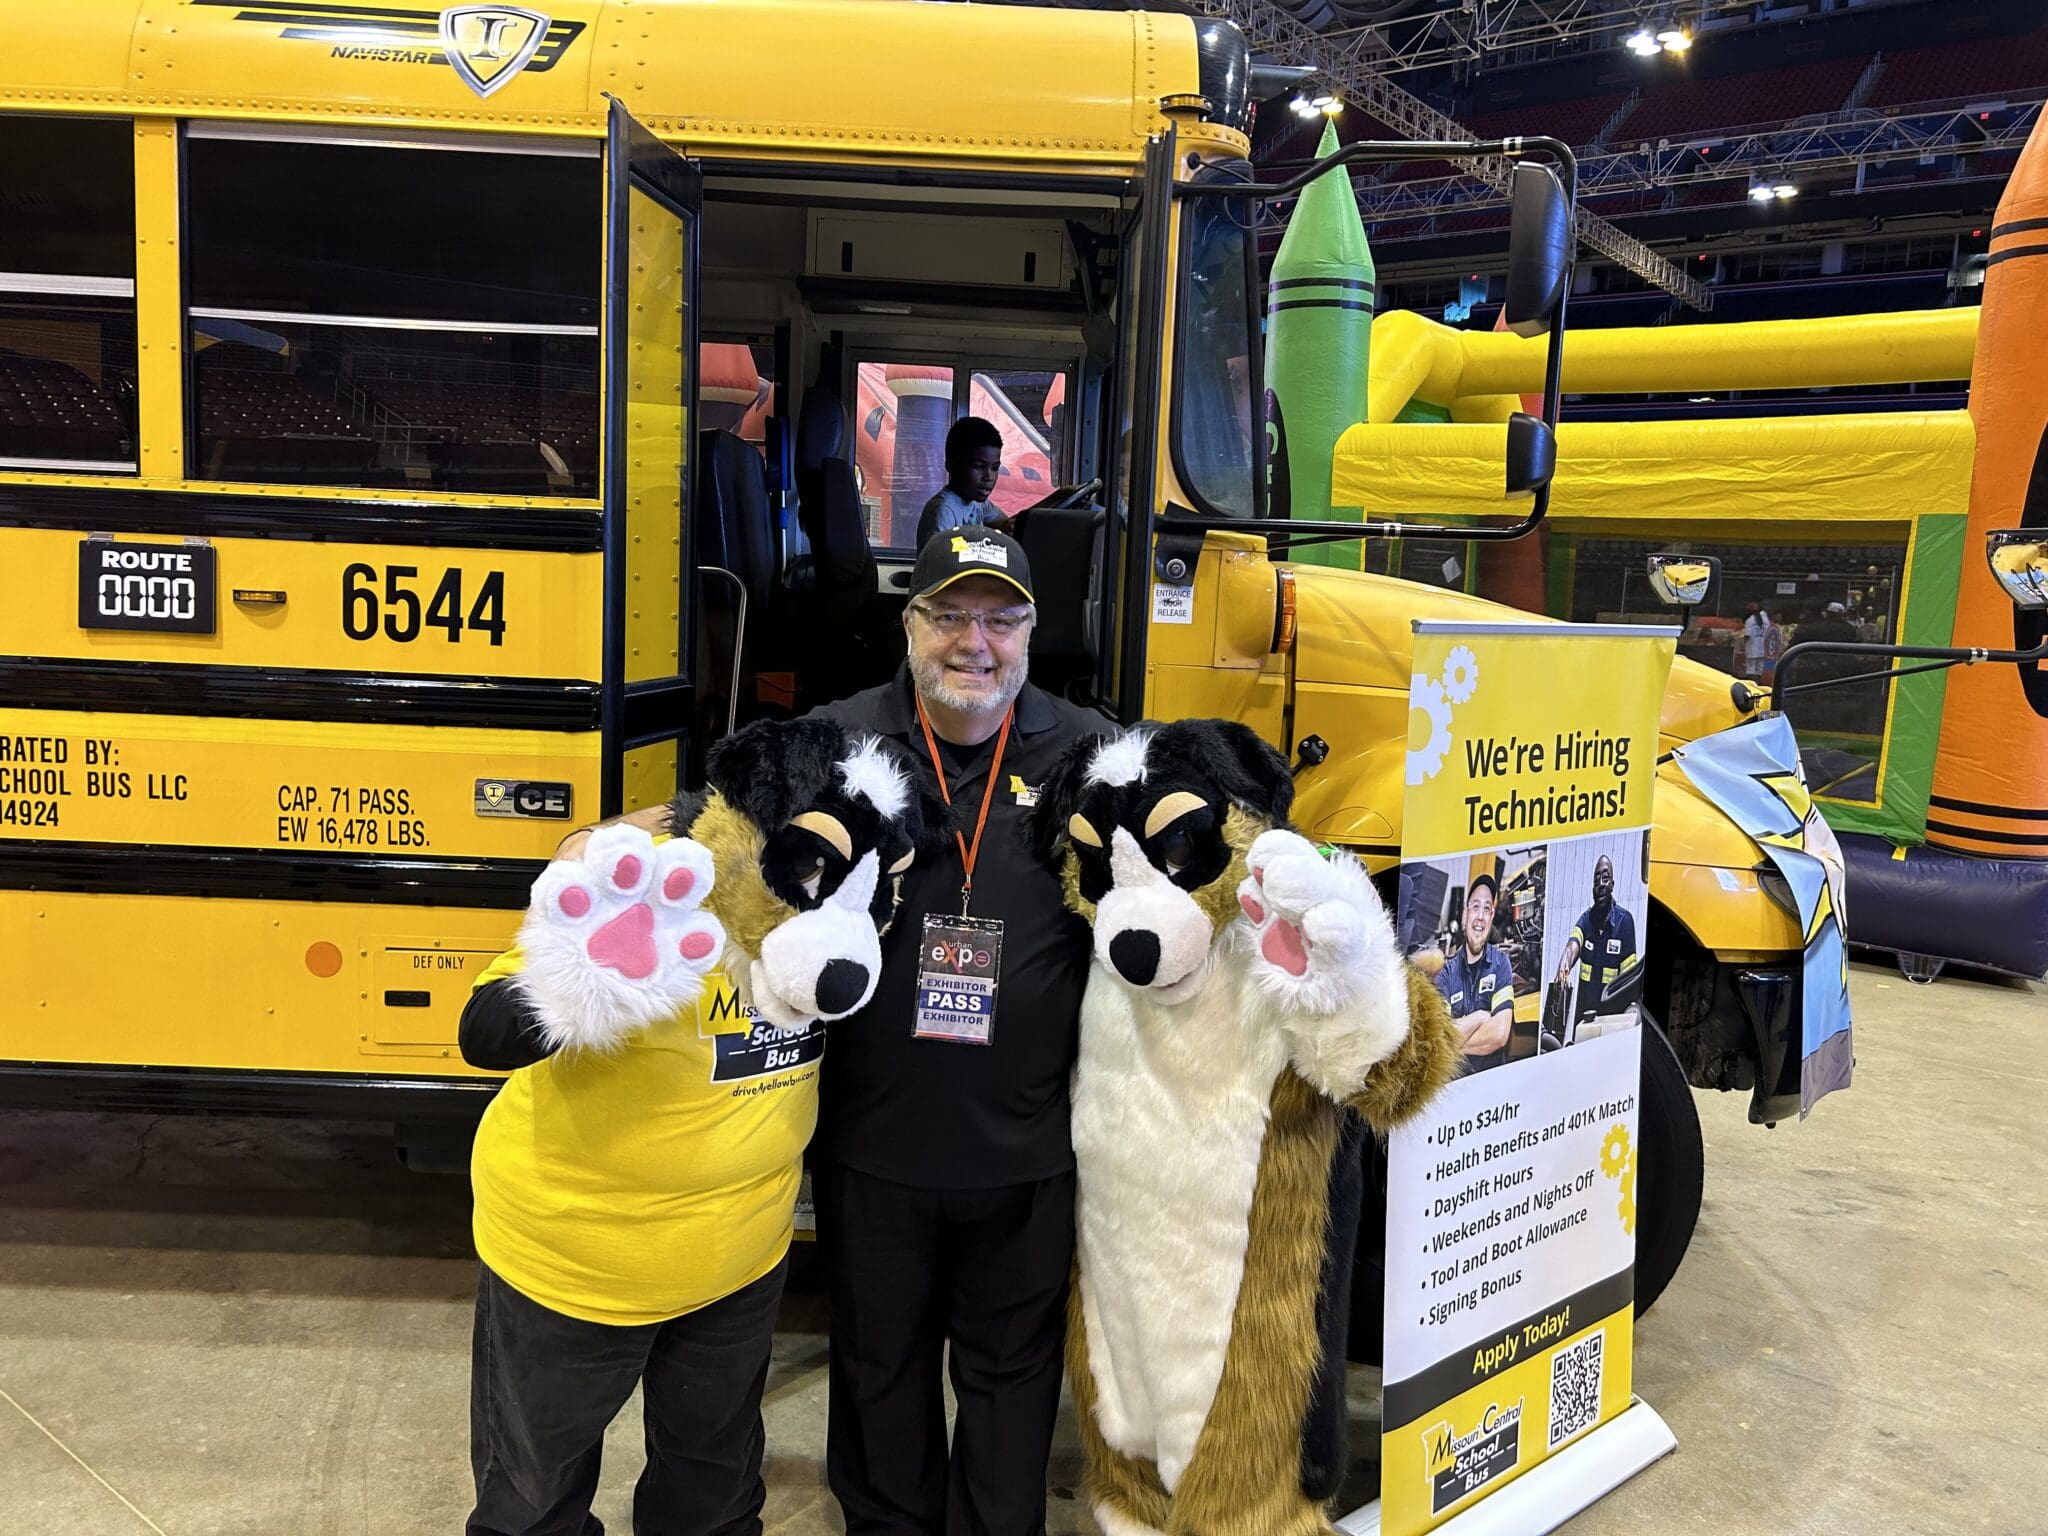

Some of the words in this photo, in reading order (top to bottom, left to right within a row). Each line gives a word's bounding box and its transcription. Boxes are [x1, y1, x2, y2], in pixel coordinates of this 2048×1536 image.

[330, 46, 430, 64] NAVISTAR
[102, 550, 192, 572] ROUTE
[99, 574, 195, 619] 0000
[341, 562, 506, 647] 6544
[1156, 590, 1191, 598] ENTRANCE
[1158, 609, 1186, 617] RELEASE
[0, 736, 67, 763] RATED
[86, 740, 119, 766] BY:
[1555, 729, 1631, 776] Hiring
[0, 768, 71, 795] CHOOL
[88, 771, 131, 798] BUS
[149, 774, 187, 800] LLC
[278, 785, 322, 812] CAP.
[331, 788, 350, 813] 71
[359, 788, 415, 815] PASS.
[520, 789, 565, 811] CE
[1465, 781, 1626, 835] Technicians!
[278, 816, 308, 842] EW
[317, 817, 377, 848] 16,478
[388, 820, 430, 846] LBS.
[413, 955, 433, 968] DEF
[437, 955, 464, 969] ONLY
[927, 978, 987, 992] EXHIBITOR
[927, 991, 981, 1011] PASS
[708, 986, 759, 1021] Miss
[923, 1012, 983, 1025] EXHIBITOR
[764, 1048, 800, 1069] Bus
[1435, 1148, 1480, 1182] Health
[1484, 1130, 1539, 1162] Benefits
[1542, 1117, 1565, 1142] and
[1567, 1106, 1596, 1131] 401K
[1599, 1094, 1634, 1121] Match
[1437, 1125, 1455, 1147] Up
[1459, 1119, 1472, 1136] to
[1476, 1102, 1520, 1131] $34/hr
[1434, 1180, 1490, 1217] Dayshift
[1494, 1165, 1533, 1193] Hours
[1432, 1209, 1501, 1254] Weekends
[1504, 1199, 1529, 1222] and
[1533, 1182, 1572, 1213] Nights
[1575, 1169, 1595, 1192] Off
[1430, 1259, 1459, 1289] Tool
[1462, 1246, 1487, 1274] and
[1492, 1235, 1523, 1261] Boot
[1525, 1207, 1587, 1247] Allowance
[1429, 1289, 1477, 1326] Signing
[1481, 1268, 1522, 1299] Bonus
[1473, 1333, 1519, 1375] Apply
[1523, 1305, 1570, 1347] Today!
[1432, 1426, 1480, 1466] Missouri
[1482, 1397, 1524, 1435] Central
[1454, 1435, 1500, 1475] School
[1464, 1466, 1489, 1491] Bus
